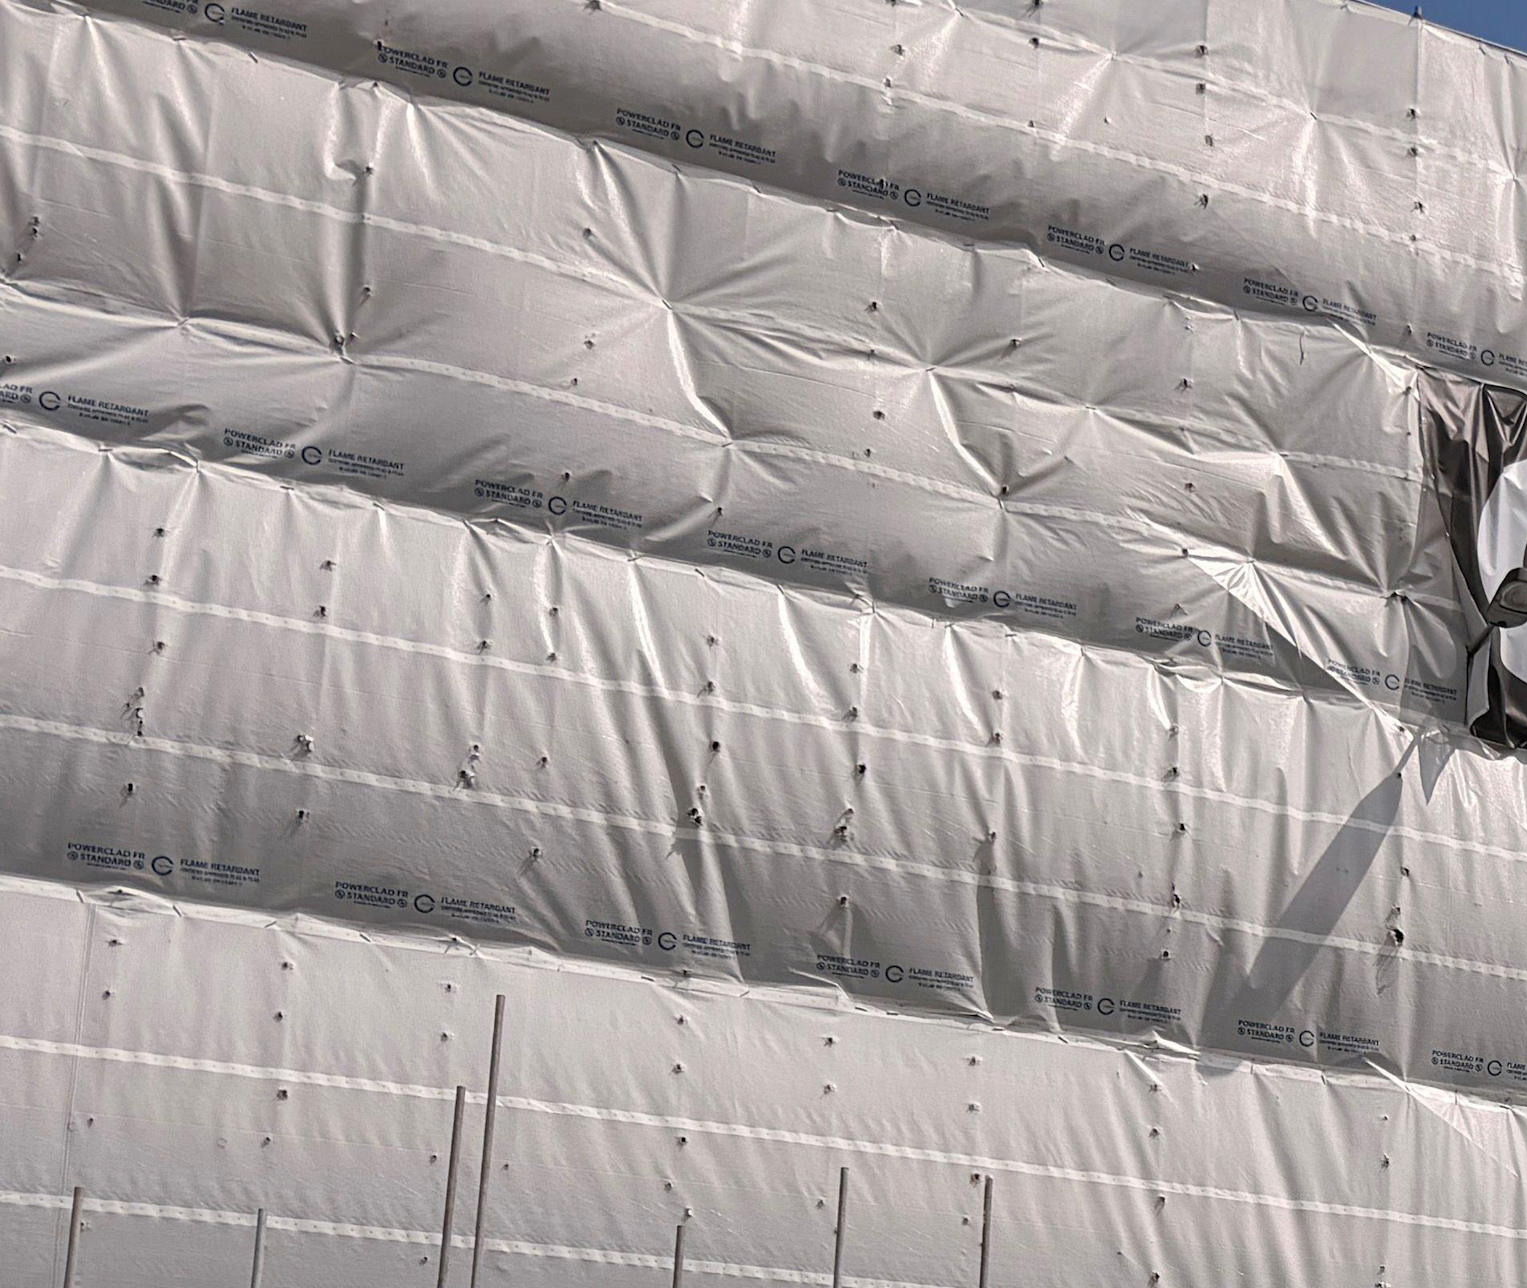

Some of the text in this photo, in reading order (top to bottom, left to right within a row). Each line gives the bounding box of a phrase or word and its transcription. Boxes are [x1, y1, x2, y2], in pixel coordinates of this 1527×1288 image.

[224, 428, 283, 448] POWERCLAD
[236, 440, 282, 456] STANDARD
[328, 449, 355, 461] FLAME
[357, 455, 404, 470] RETARDANT
[68, 843, 145, 860] POWERCLAD FR
[80, 852, 131, 867] STANDARD
[180, 858, 208, 870] FLAME
[211, 862, 260, 877] RETARDANT
[335, 881, 395, 896] POWERCLAD
[347, 891, 396, 906] STANDARD
[441, 896, 467, 908] FLAME
[469, 900, 516, 915] RETARDANT
